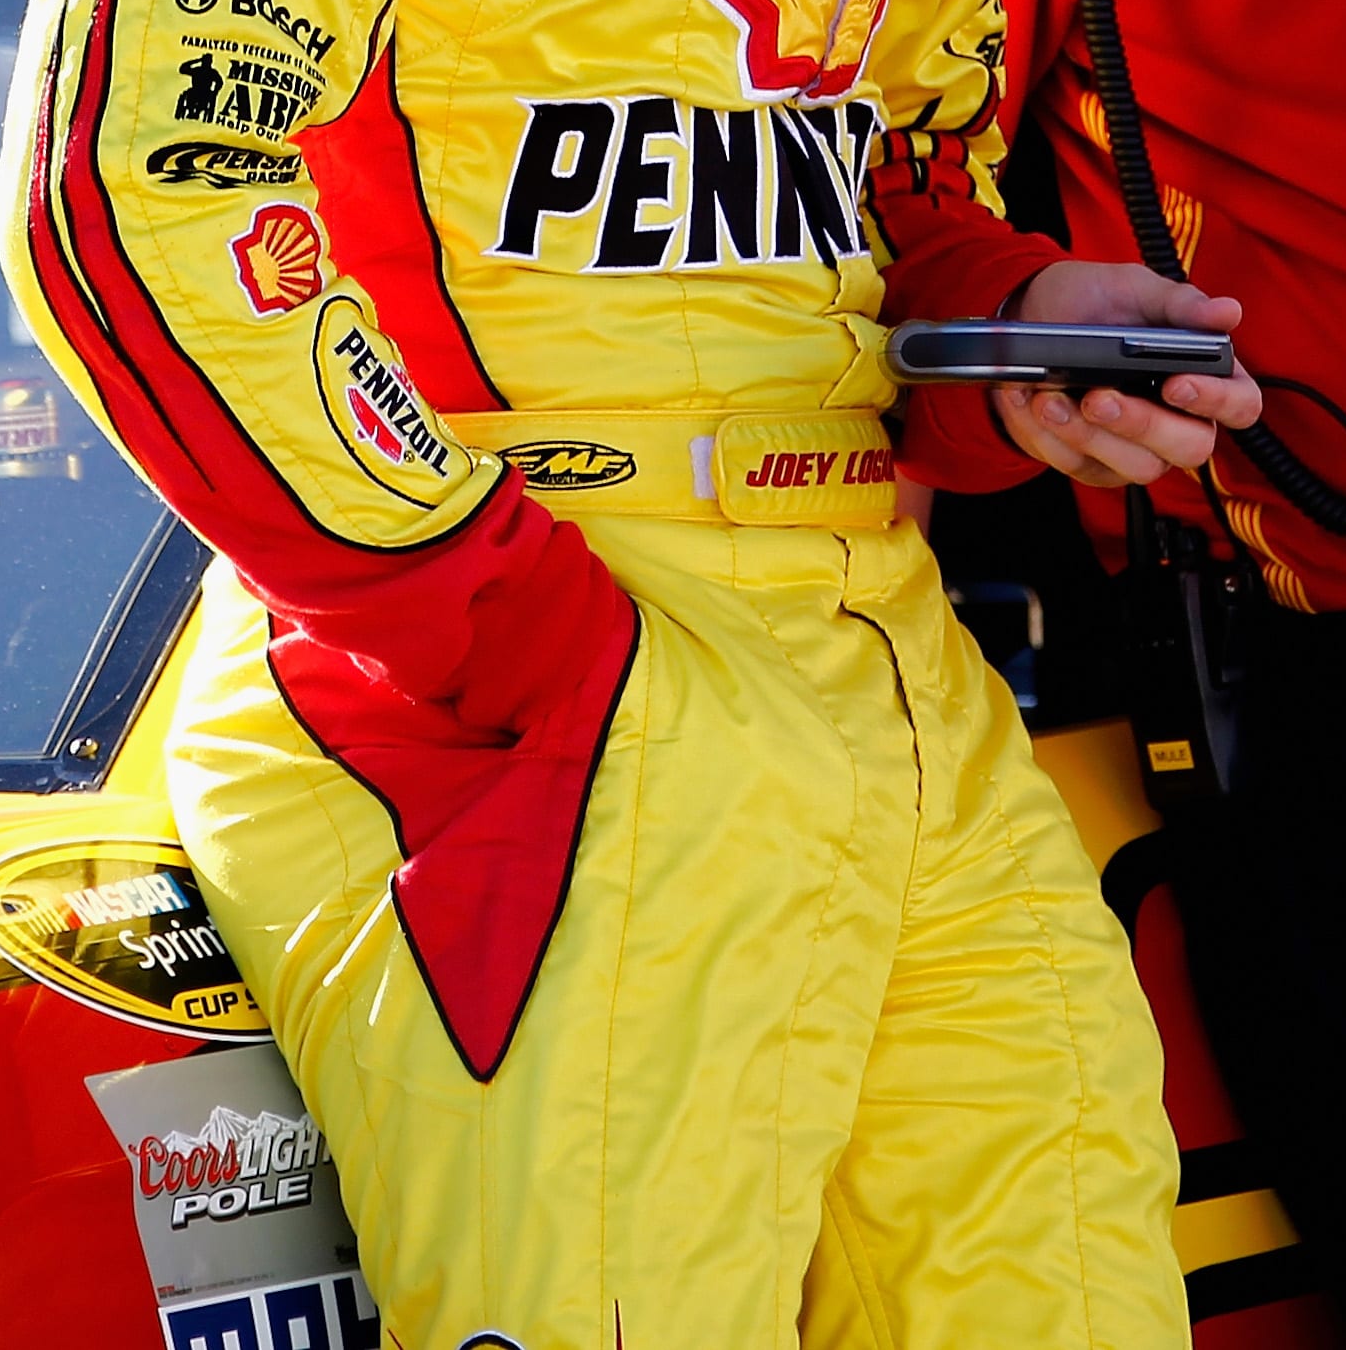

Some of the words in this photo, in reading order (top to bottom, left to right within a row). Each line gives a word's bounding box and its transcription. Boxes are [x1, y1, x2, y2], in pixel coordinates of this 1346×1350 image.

[181, 35, 239, 53] PARALYZED
[243, 43, 292, 65] VETERANS
[216, 115, 250, 135] Help
[255, 125, 282, 142] Our
[205, 150, 302, 170] PENSK
[334, 325, 449, 478] PENNZOIL
[745, 452, 839, 489] JOEY
[64, 871, 185, 927] NASCAR
[184, 991, 239, 1020] CUP
[128, 1134, 242, 1199] Coors
[171, 1174, 313, 1231] POLE
